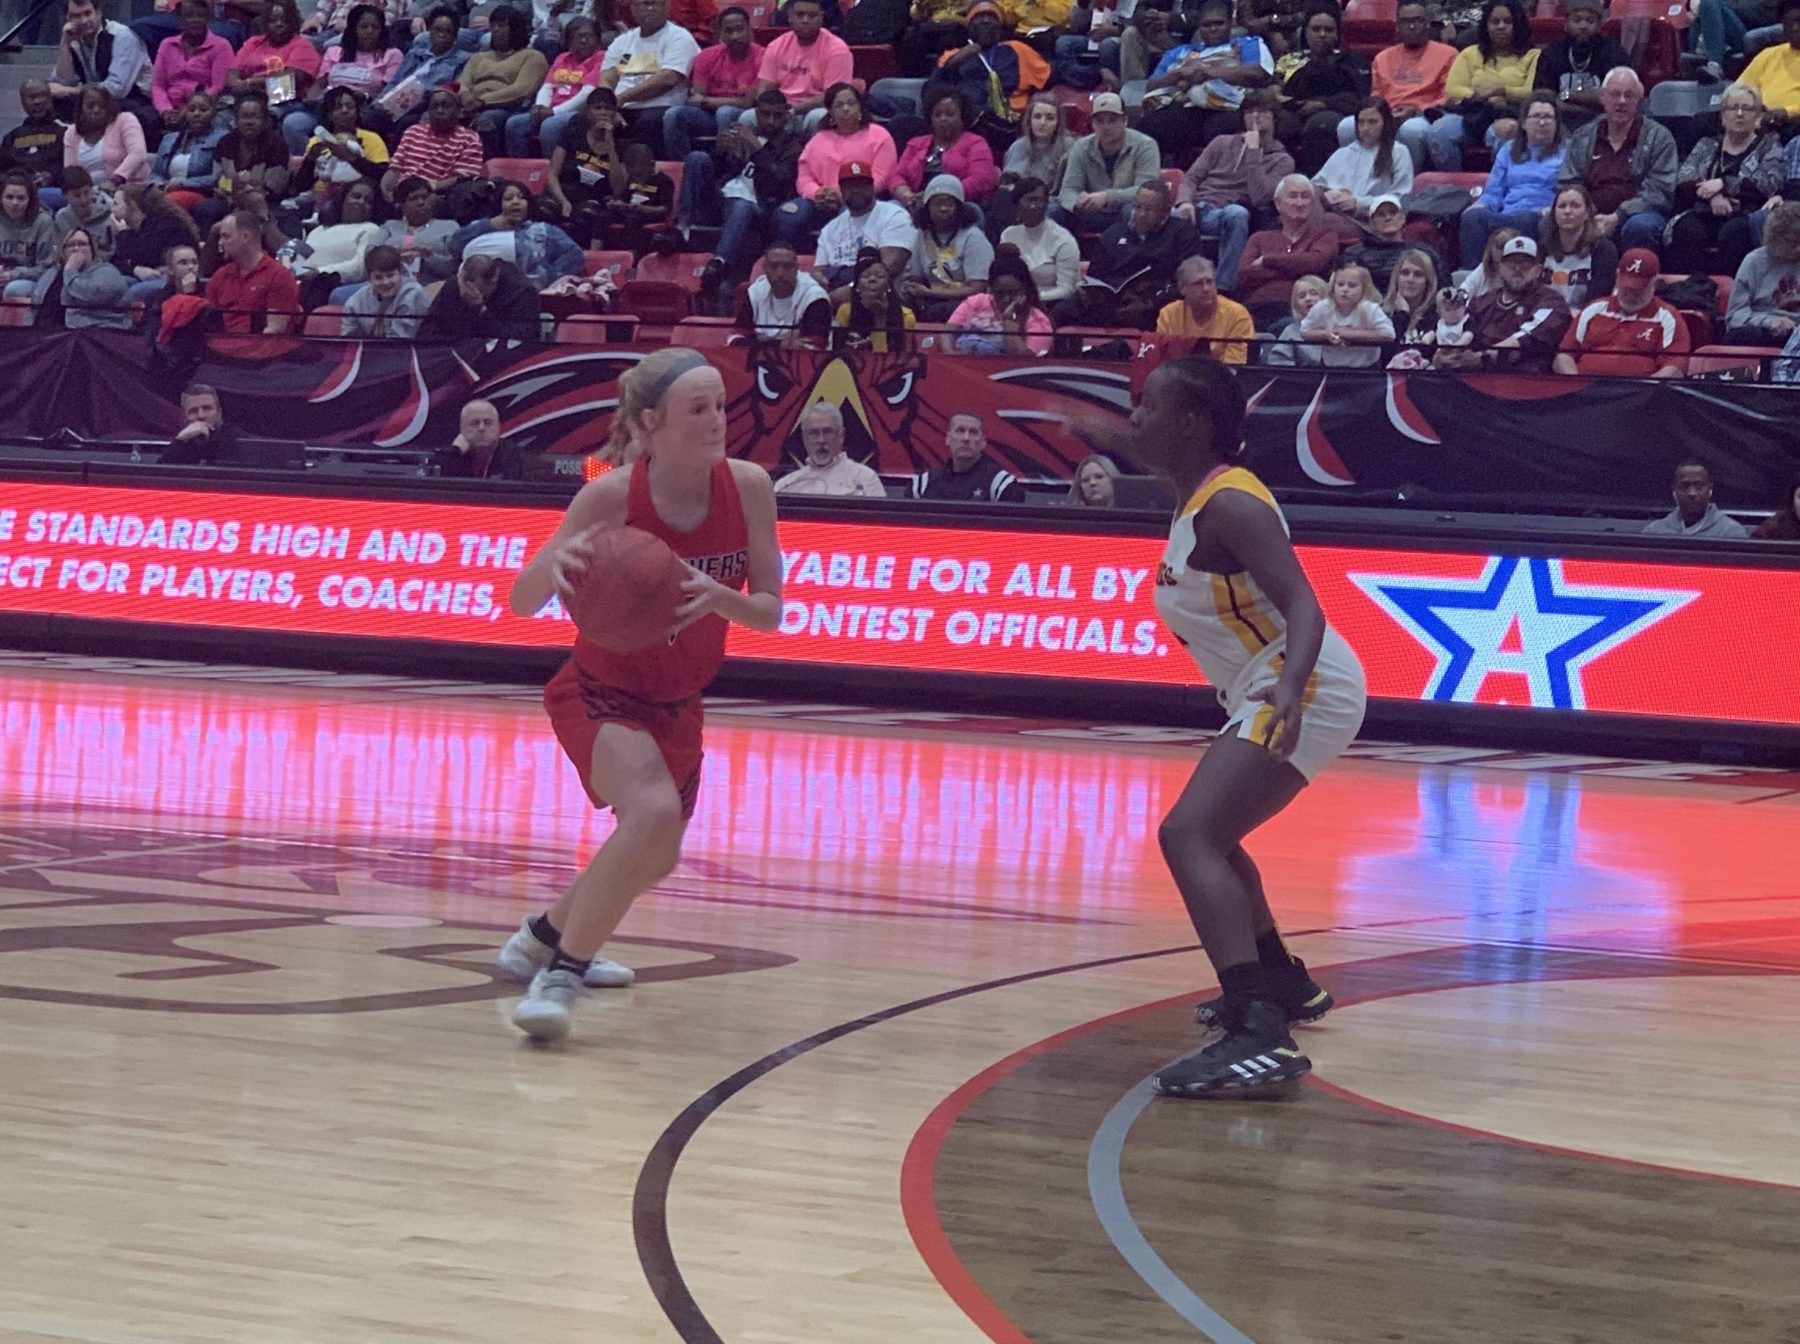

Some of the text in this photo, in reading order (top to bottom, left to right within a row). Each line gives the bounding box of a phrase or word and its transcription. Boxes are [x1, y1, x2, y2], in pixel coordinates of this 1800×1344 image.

[24, 510, 241, 555] STANDARDS
[250, 522, 351, 560] HIGH
[358, 529, 447, 564] AND
[459, 533, 528, 569] THE
[57, 558, 131, 594] FOR
[139, 563, 304, 609] PLAYERS,
[317, 574, 504, 620] COACHES,
[907, 557, 992, 594] FOR
[1002, 562, 1077, 599] ALL
[1091, 566, 1149, 603] BY
[944, 610, 1169, 657] OFFICIALS.
